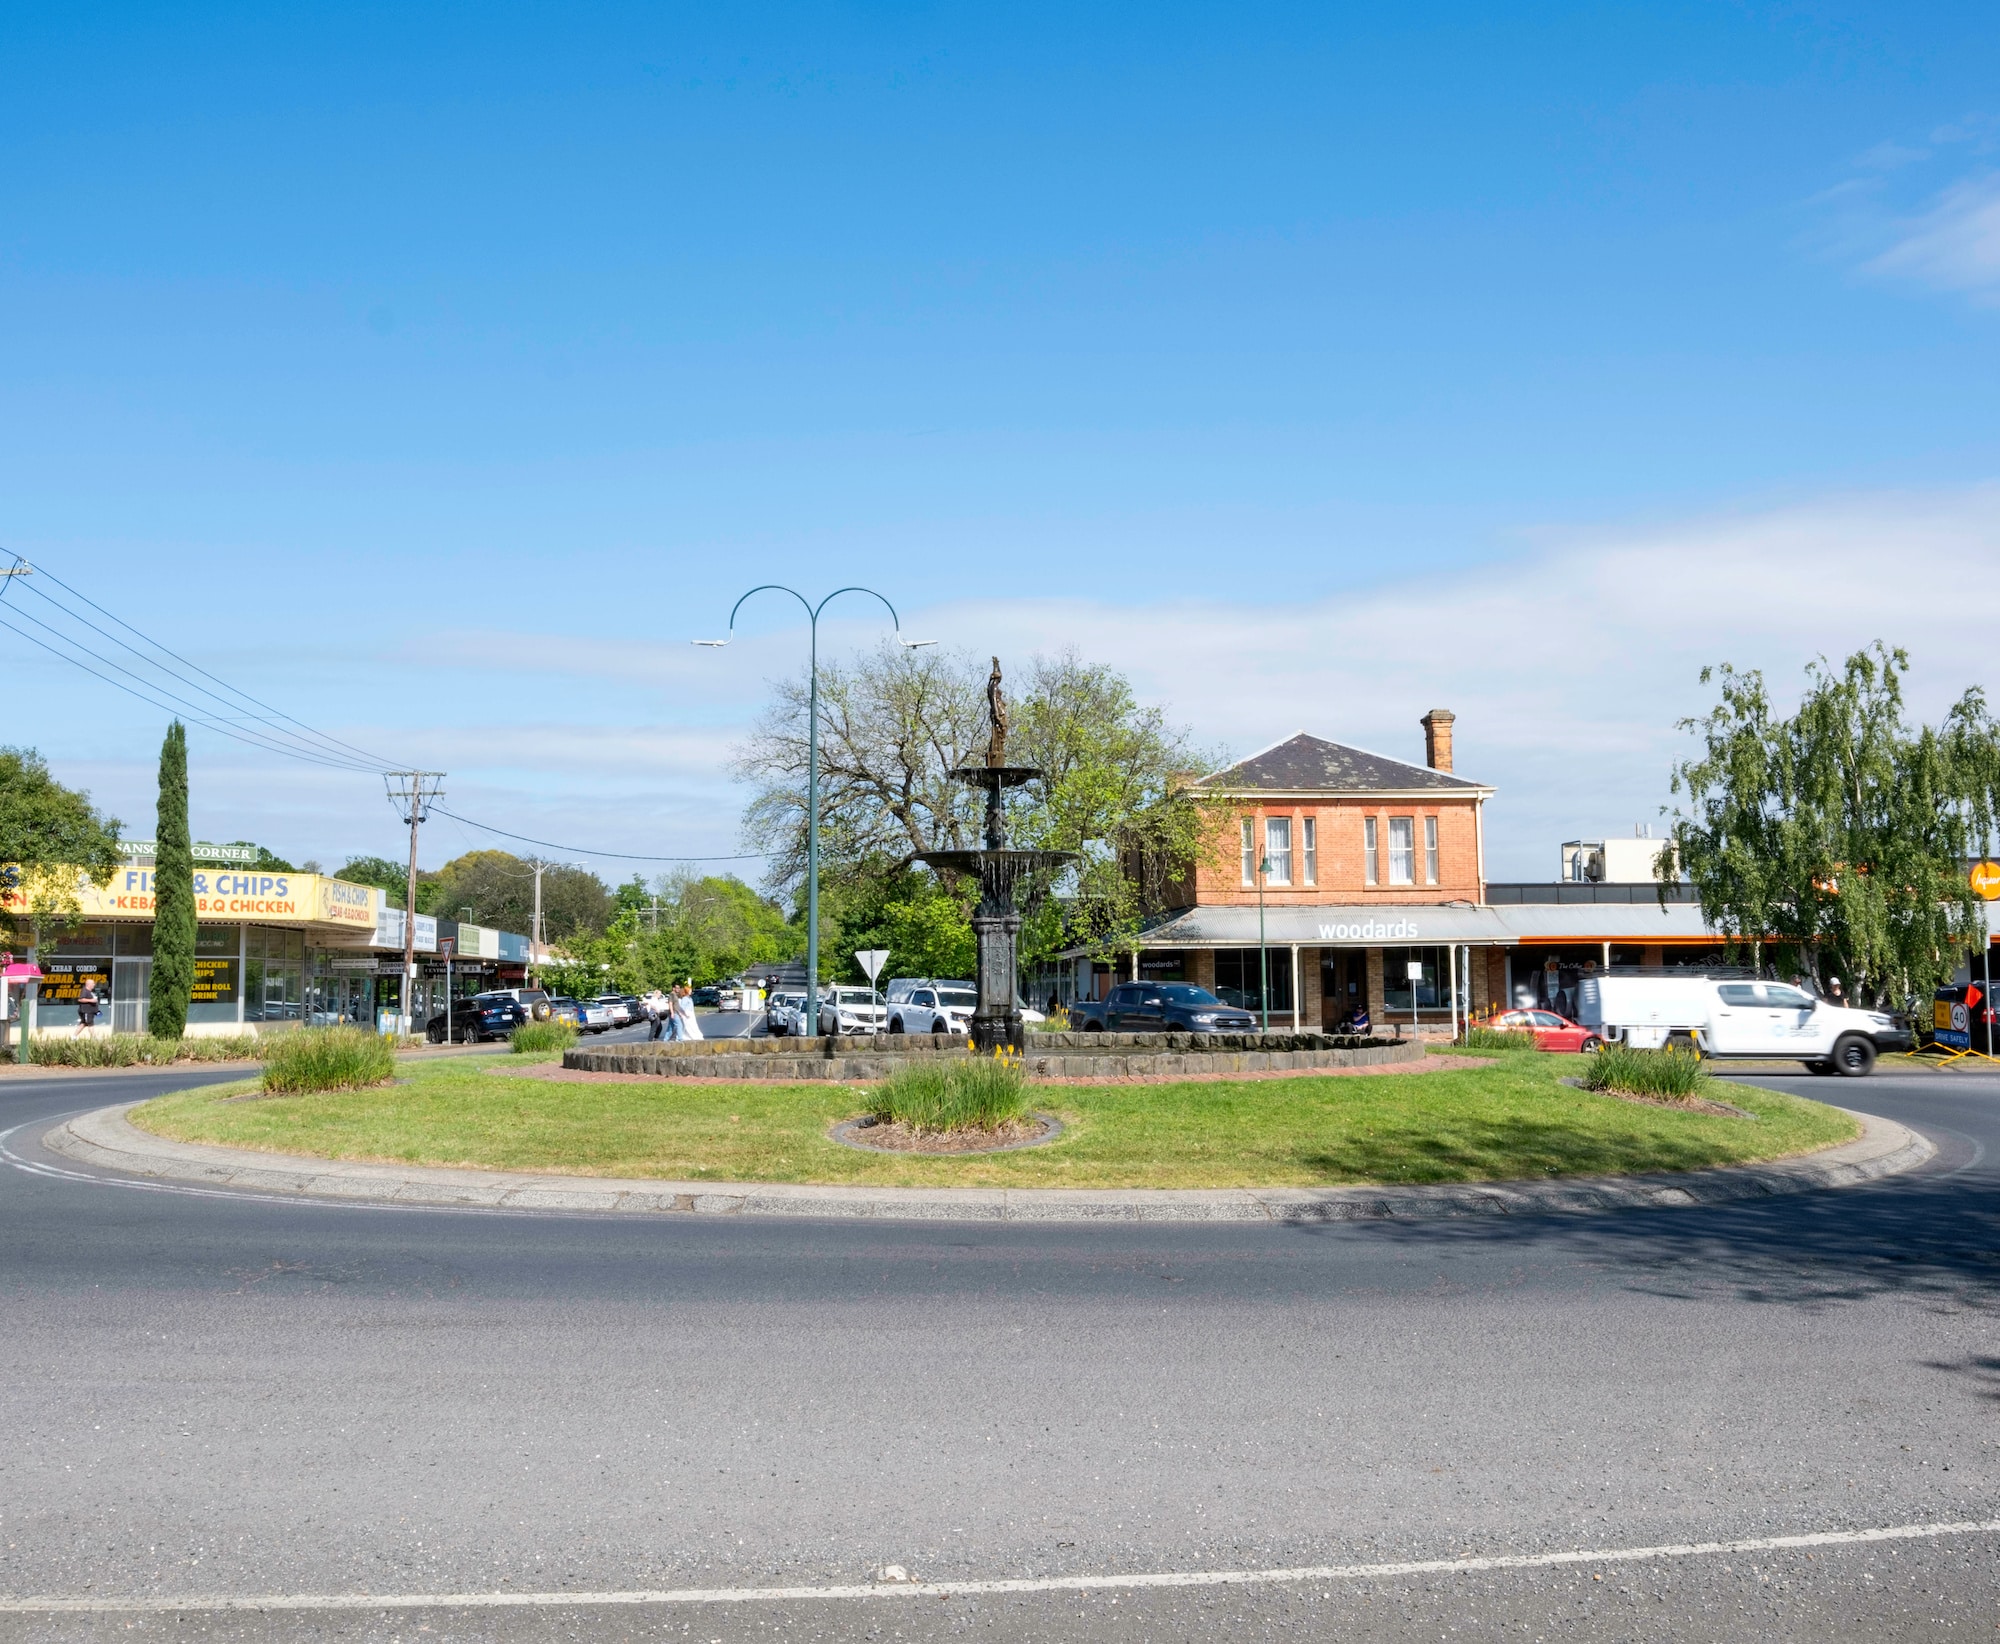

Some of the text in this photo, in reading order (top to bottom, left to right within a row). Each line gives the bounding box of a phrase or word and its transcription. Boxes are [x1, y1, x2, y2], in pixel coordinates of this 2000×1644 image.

[191, 847, 251, 859] CORNER
[126, 871, 289, 897] FI & CHIPS
[332, 883, 346, 903] FISH
[352, 888, 368, 907] CHIPS
[117, 896, 157, 909] KEBA
[230, 900, 295, 914] CHICKEN
[1318, 918, 1418, 938] woodards
[55, 988, 81, 998] DRIN
[212, 983, 232, 991] ROLL
[192, 992, 218, 1000] DRINK
[1954, 1012, 1964, 1024] 40
[1935, 1032, 1968, 1044] DRIVE SAFELY
